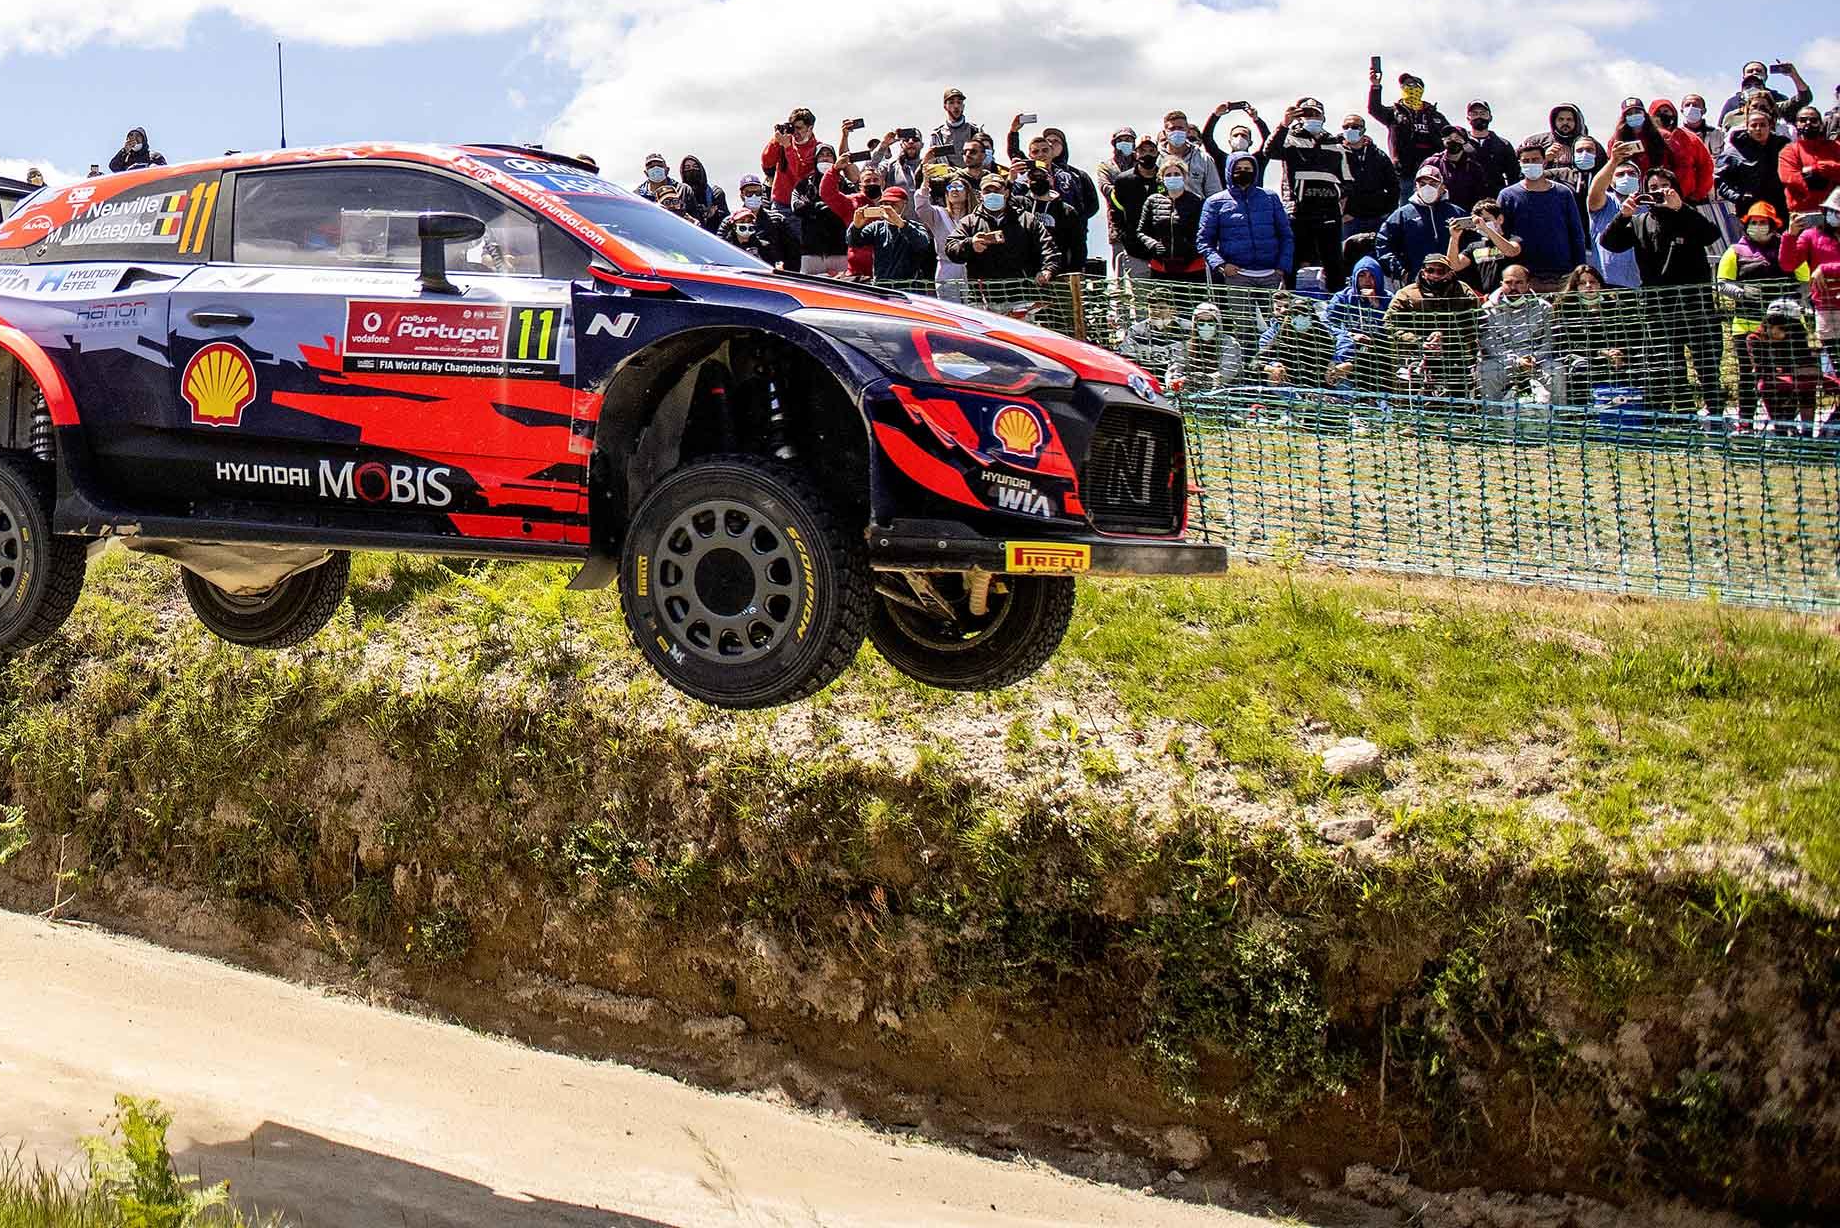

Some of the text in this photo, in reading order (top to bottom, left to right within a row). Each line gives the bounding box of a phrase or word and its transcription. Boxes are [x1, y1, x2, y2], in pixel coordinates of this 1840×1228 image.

[71, 194, 160, 221] T. Neuville
[177, 180, 221, 254] 11
[44, 220, 153, 245] M. Wydaeghe
[67, 267, 121, 280] HYUNDAI
[60, 280, 98, 292] STEEL
[400, 315, 438, 324] rally de
[351, 334, 390, 344] vodafone
[397, 322, 500, 343] Portugal
[517, 308, 554, 360] 11
[480, 345, 499, 354] 2021
[380, 360, 394, 370] FIA
[395, 360, 419, 370] World
[421, 361, 443, 373] Rally
[444, 362, 505, 376] Championship
[215, 461, 310, 487] HYUNDAI
[318, 458, 453, 507] MOBIS
[981, 469, 1032, 491] HYUNDAI
[1014, 546, 1085, 569] PIRELLI
[786, 525, 815, 643] SCORPION
